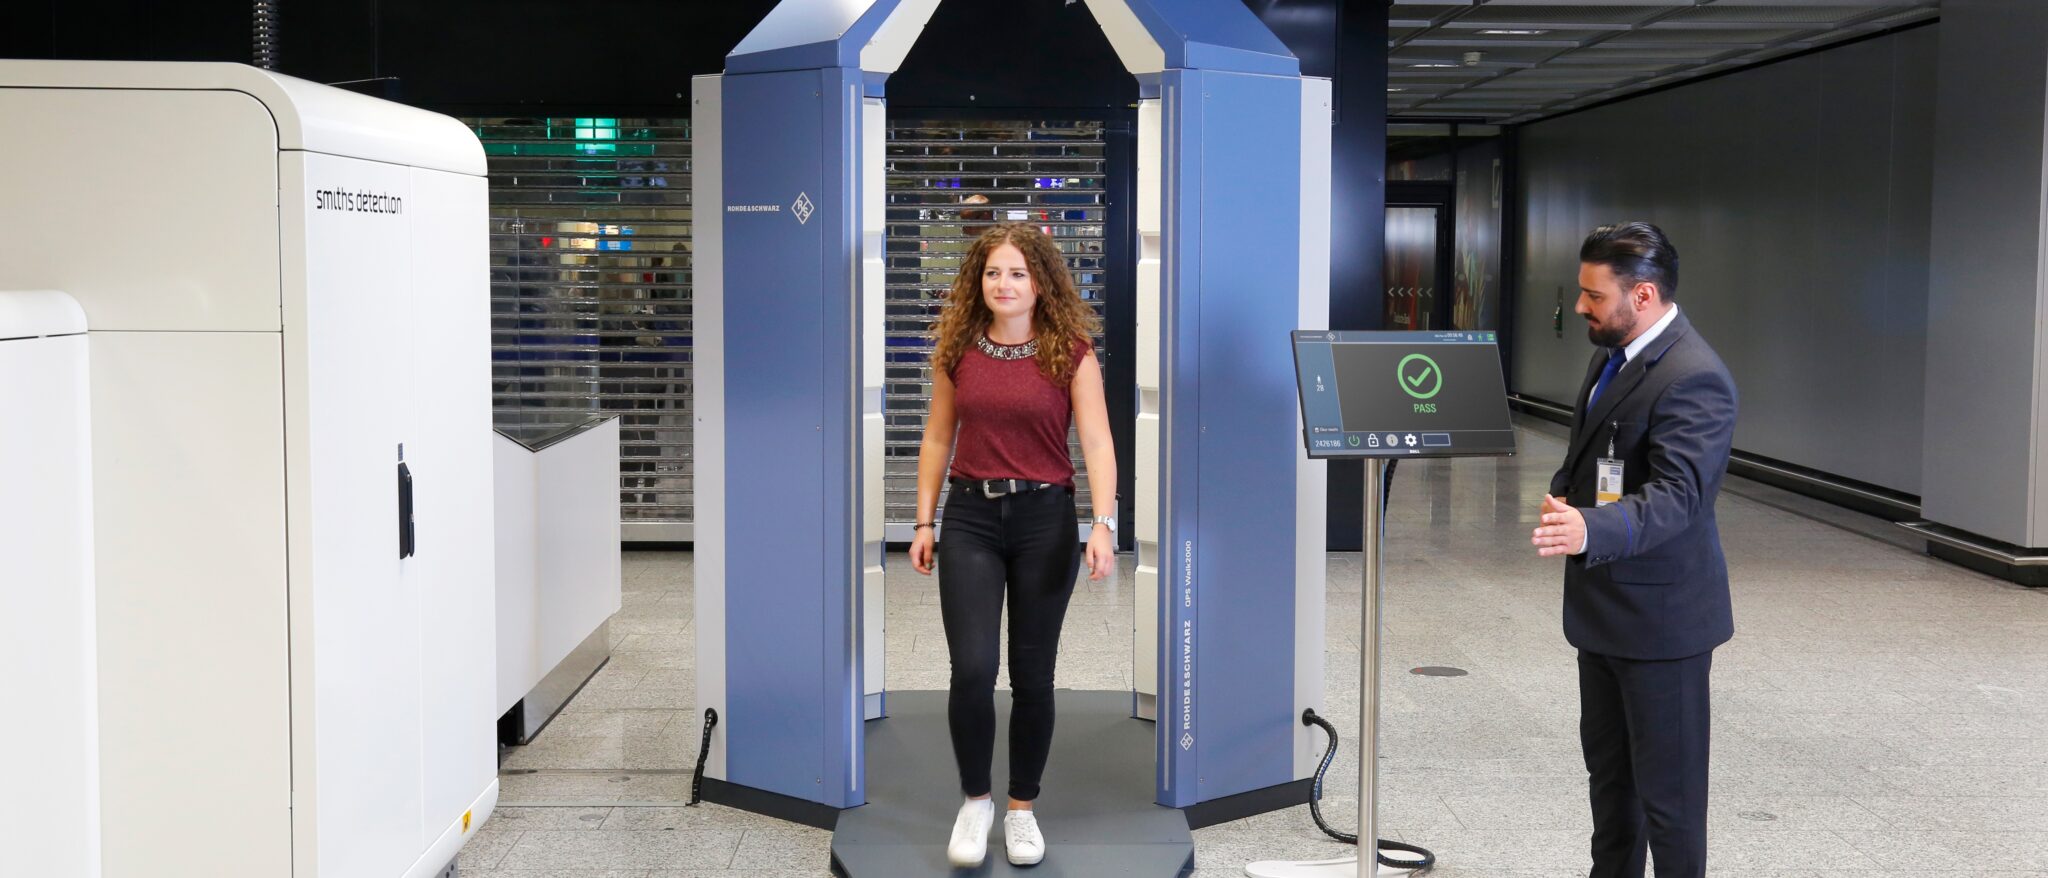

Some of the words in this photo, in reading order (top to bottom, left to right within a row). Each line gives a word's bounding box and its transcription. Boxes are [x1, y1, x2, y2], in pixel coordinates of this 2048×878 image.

[316, 187, 354, 212] smiths
[356, 188, 402, 214] detection
[1413, 403, 1437, 413] PASS
[1183, 620, 1191, 730] ROHDE&SCHWARZ
